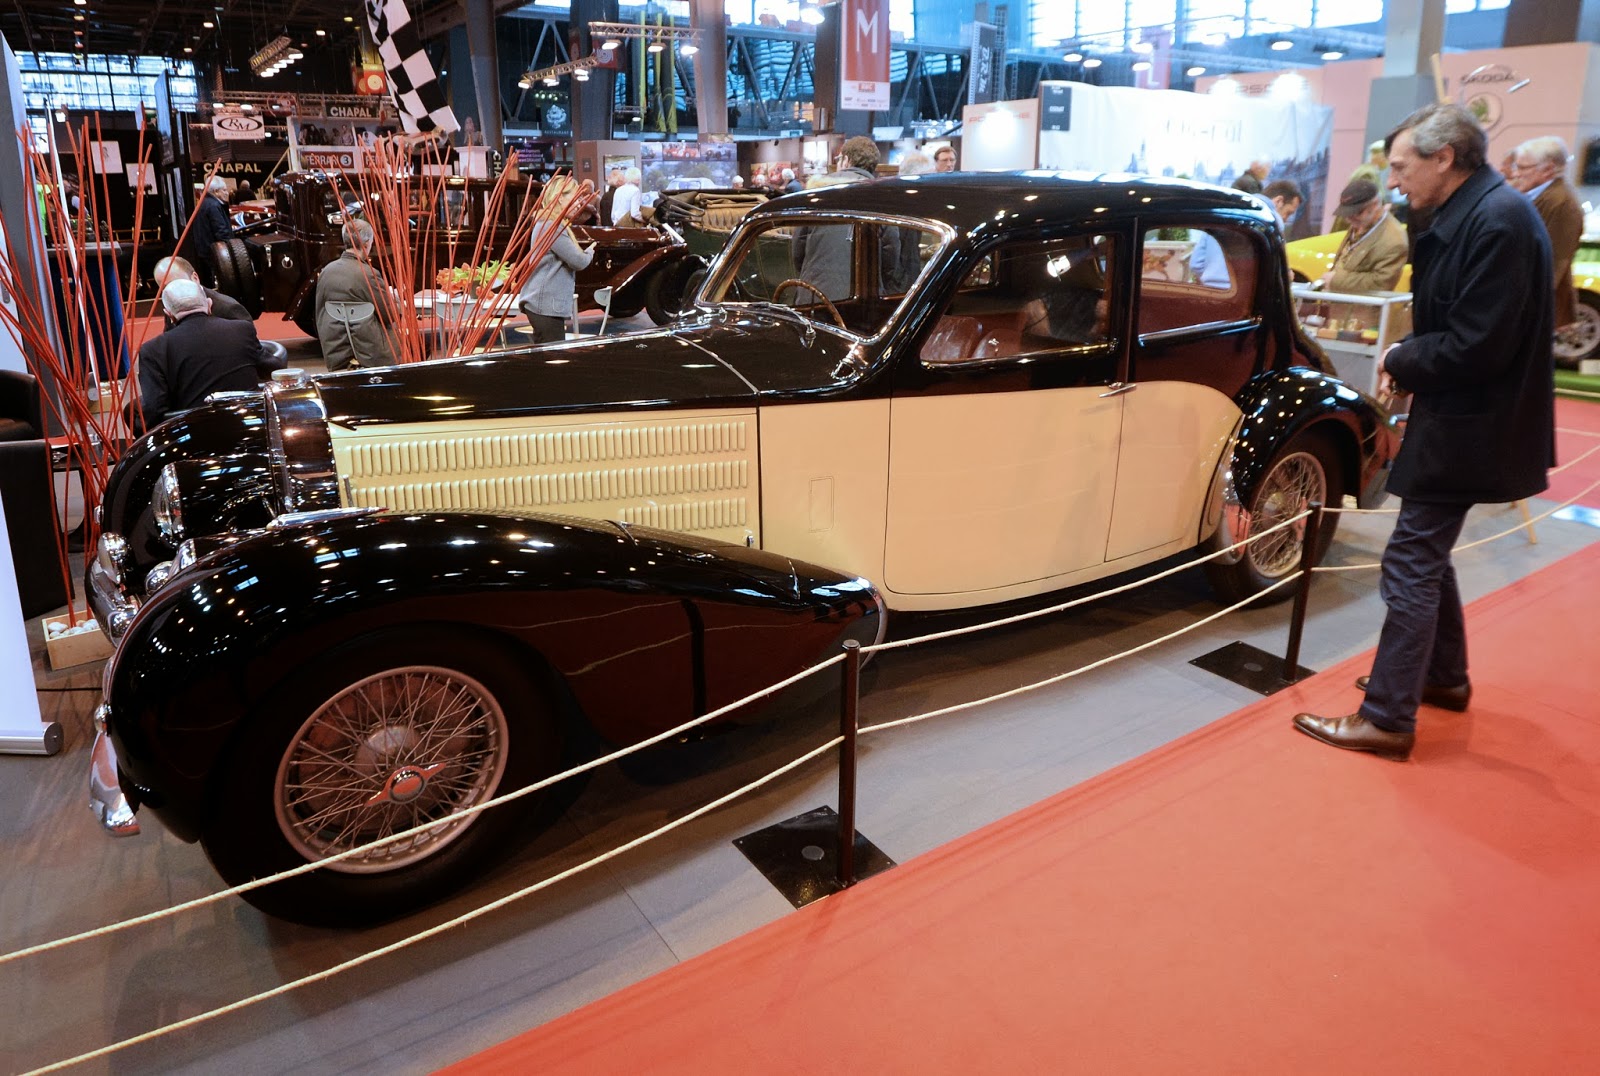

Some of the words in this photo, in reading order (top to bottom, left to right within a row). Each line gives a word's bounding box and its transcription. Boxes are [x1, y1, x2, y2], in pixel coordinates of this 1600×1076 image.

[856, 8, 879, 54] M
[330, 106, 372, 117] CHAPAL
[228, 118, 250, 131] RM
[203, 162, 262, 173] CHAPAL
